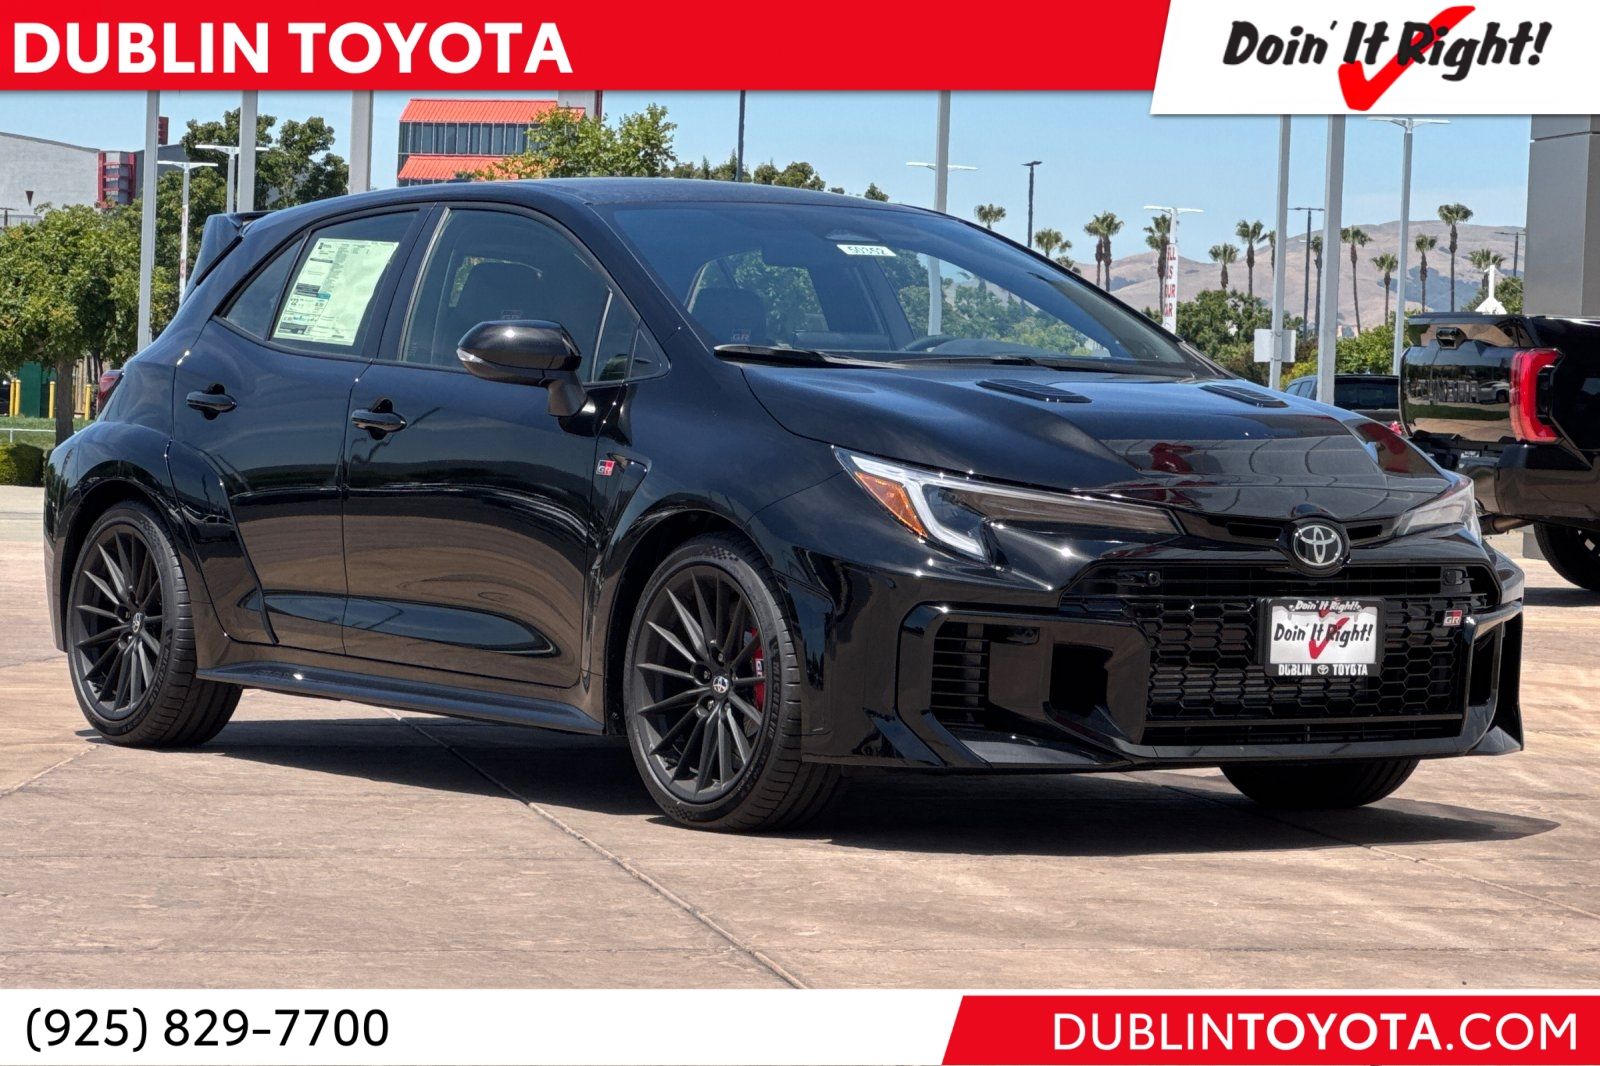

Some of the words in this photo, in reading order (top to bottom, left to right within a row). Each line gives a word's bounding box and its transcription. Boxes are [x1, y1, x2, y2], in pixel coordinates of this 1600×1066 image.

[1445, 616, 1460, 625] GR
[1274, 623, 1309, 641] Doin'
[1311, 623, 1323, 641] It
[1326, 624, 1373, 648] Right!
[1278, 664, 1312, 676] DUBLIN
[1333, 663, 1368, 676] TOYOTA
